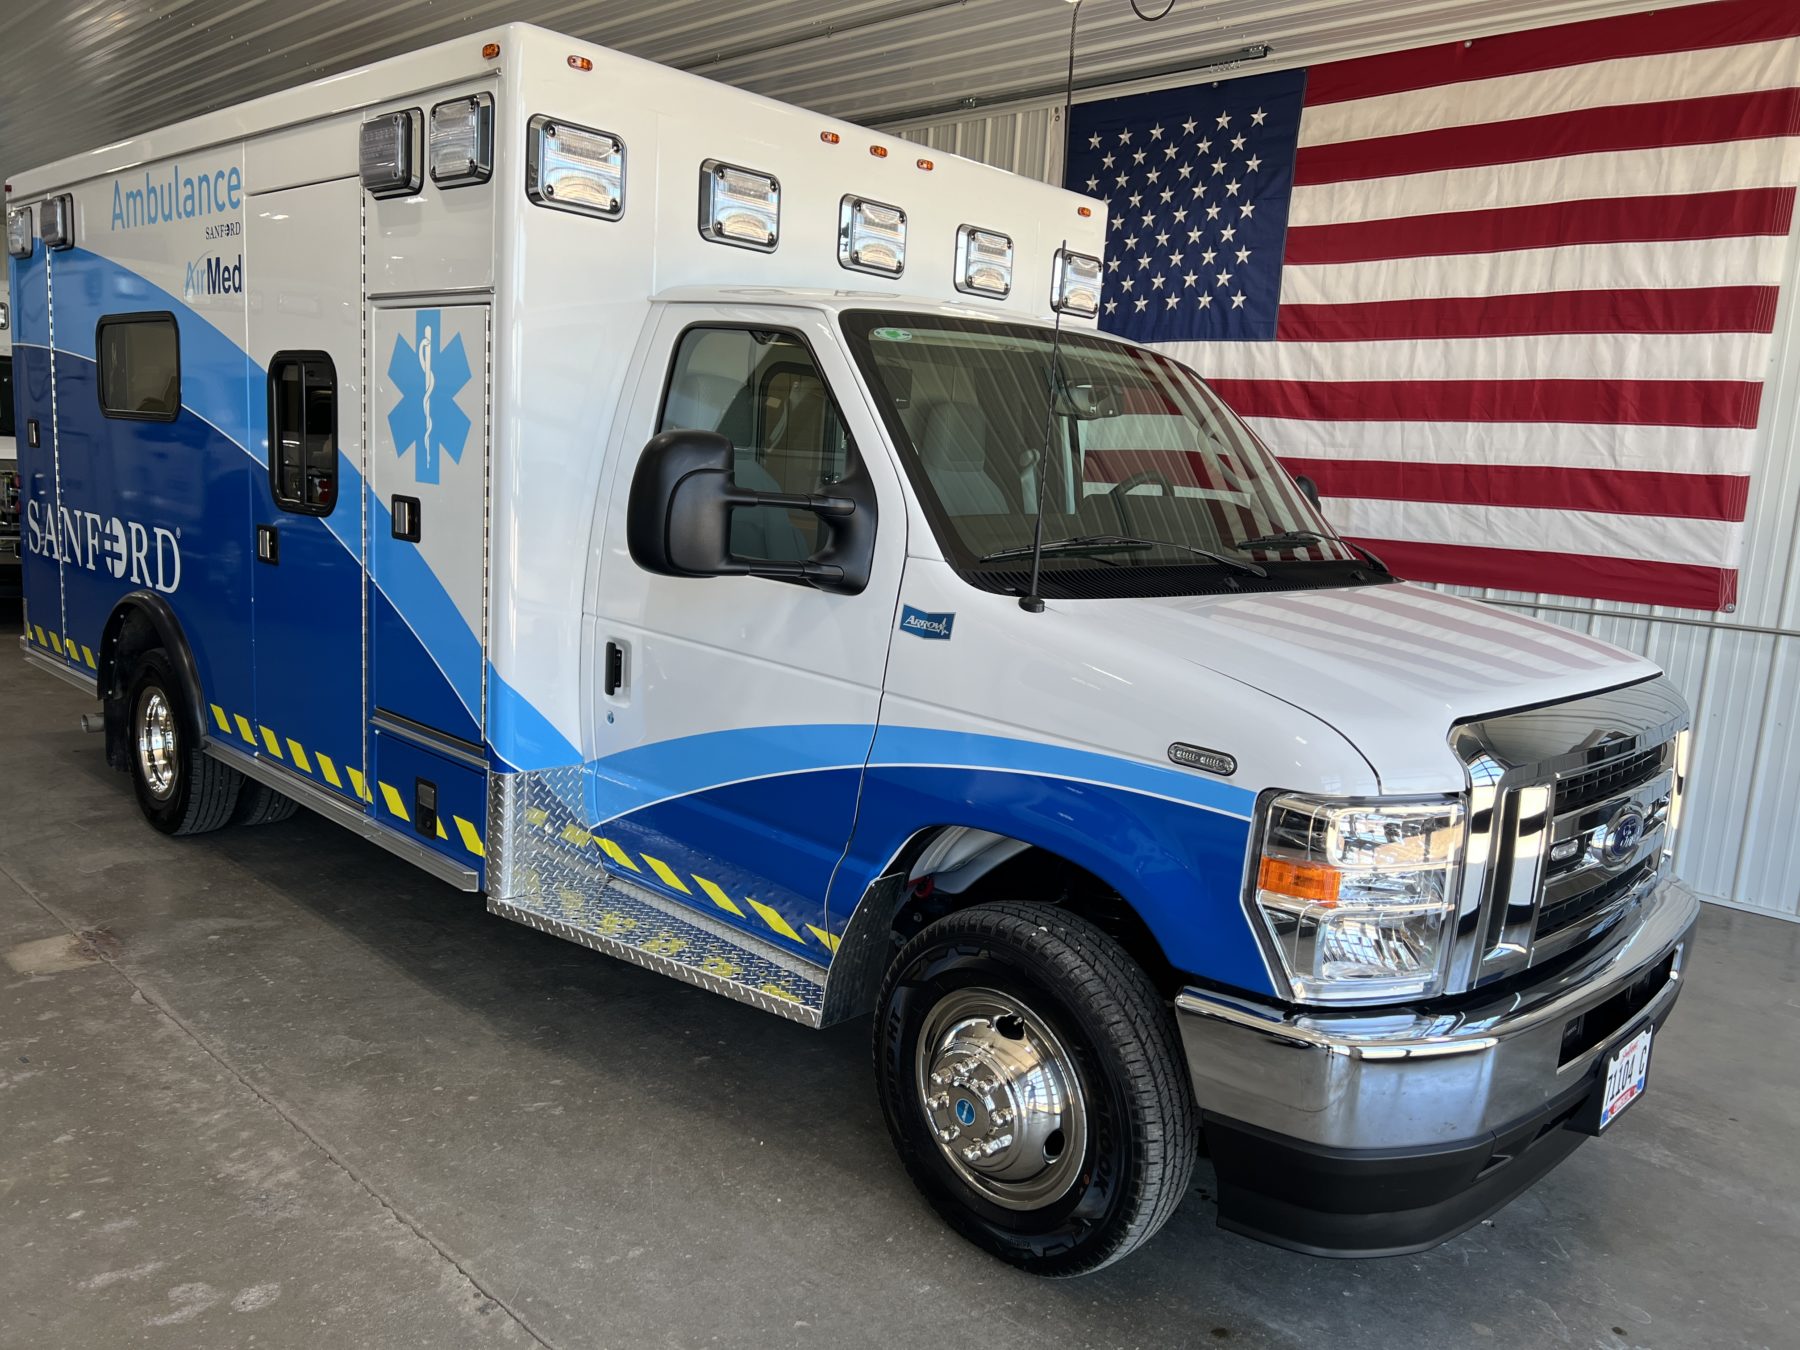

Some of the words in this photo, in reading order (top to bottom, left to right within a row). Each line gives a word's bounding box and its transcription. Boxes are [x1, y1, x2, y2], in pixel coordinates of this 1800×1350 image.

[111, 165, 242, 231] Ambulance
[205, 221, 241, 240] SANFORD
[184, 253, 242, 297] AirMed
[1605, 1053, 1636, 1107] 71104
